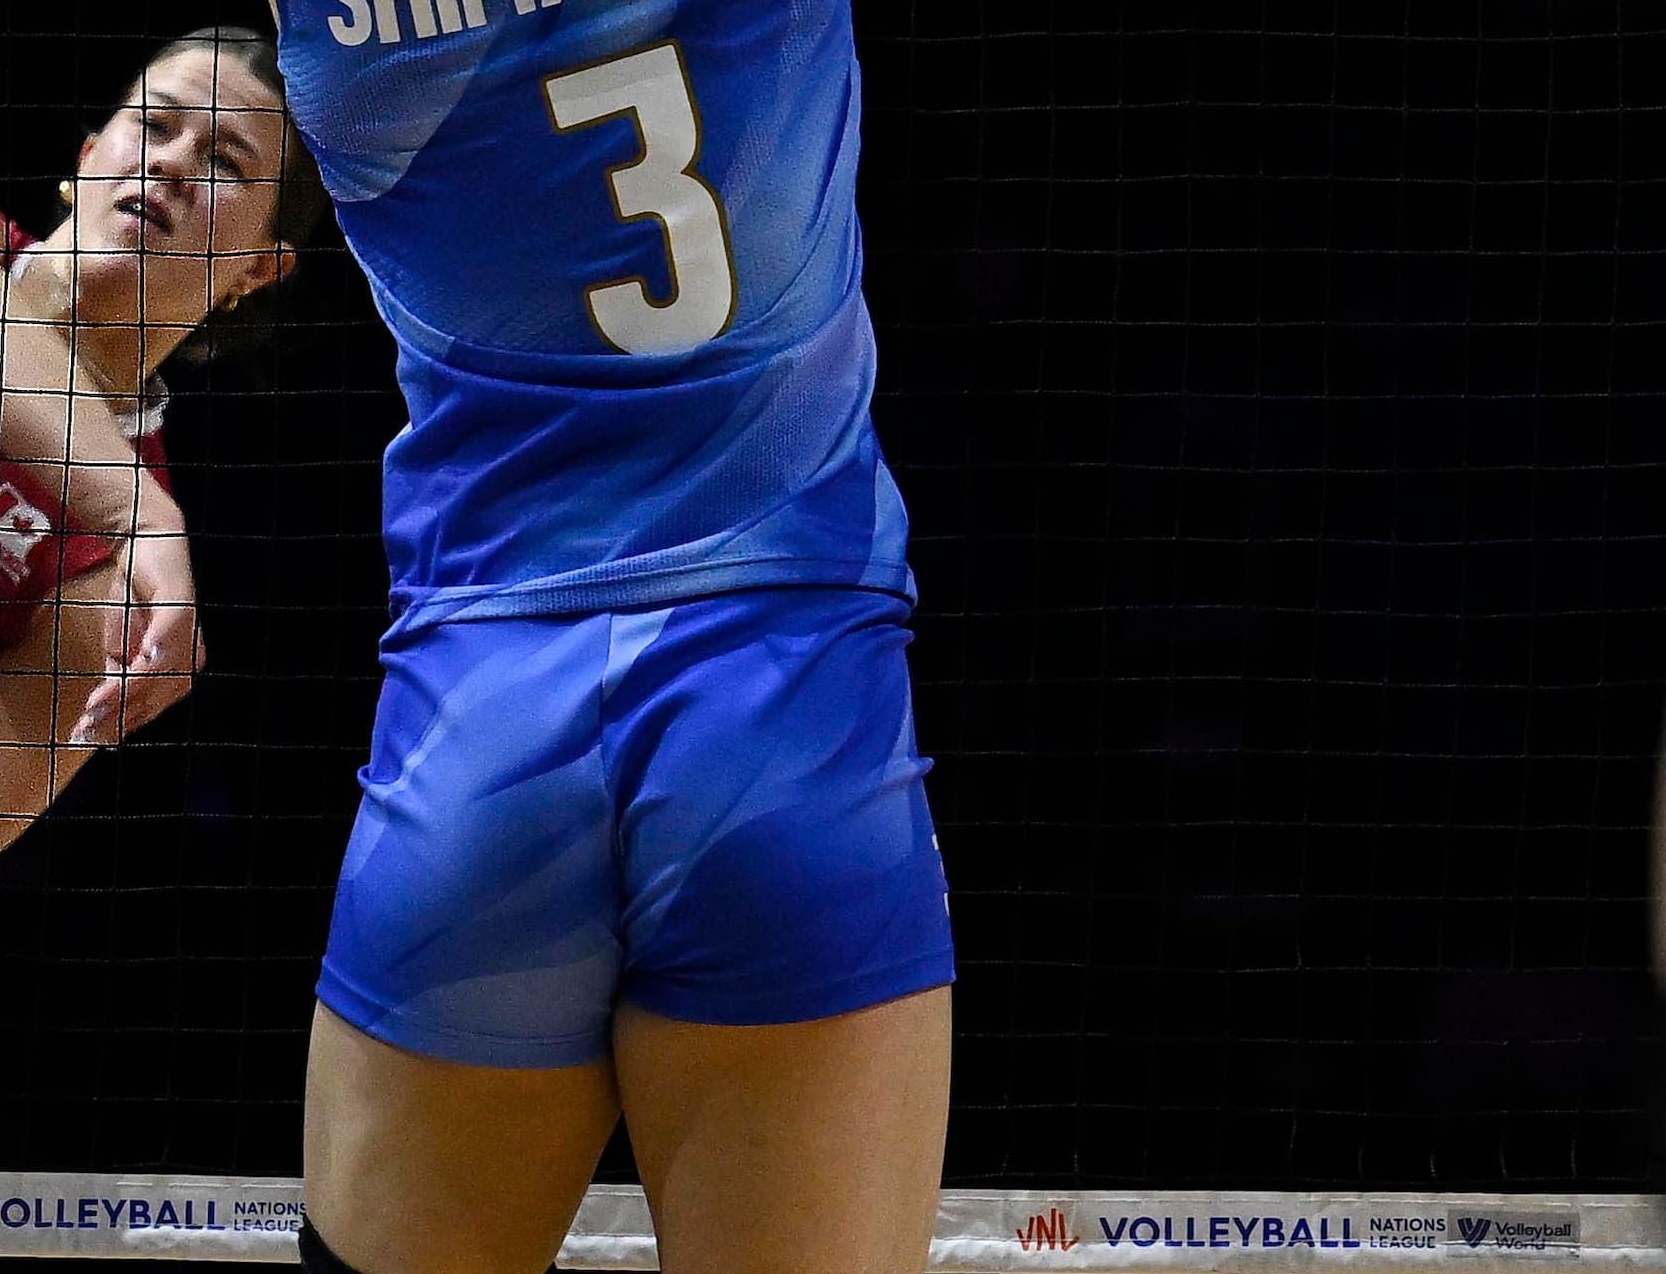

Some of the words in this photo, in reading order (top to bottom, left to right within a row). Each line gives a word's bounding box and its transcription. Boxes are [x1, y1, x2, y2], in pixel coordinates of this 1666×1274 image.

[545, 39, 735, 355] 3
[234, 1201, 307, 1215] NATIONS
[234, 1219, 299, 1232] LEAGUE
[1017, 1208, 1080, 1251] VNL
[1099, 1217, 1360, 1248] VOLLEYBALL
[1370, 1218, 1446, 1231] NATIONS
[1495, 1221, 1571, 1239] Volleyball
[1370, 1236, 1436, 1249] LEAGUE
